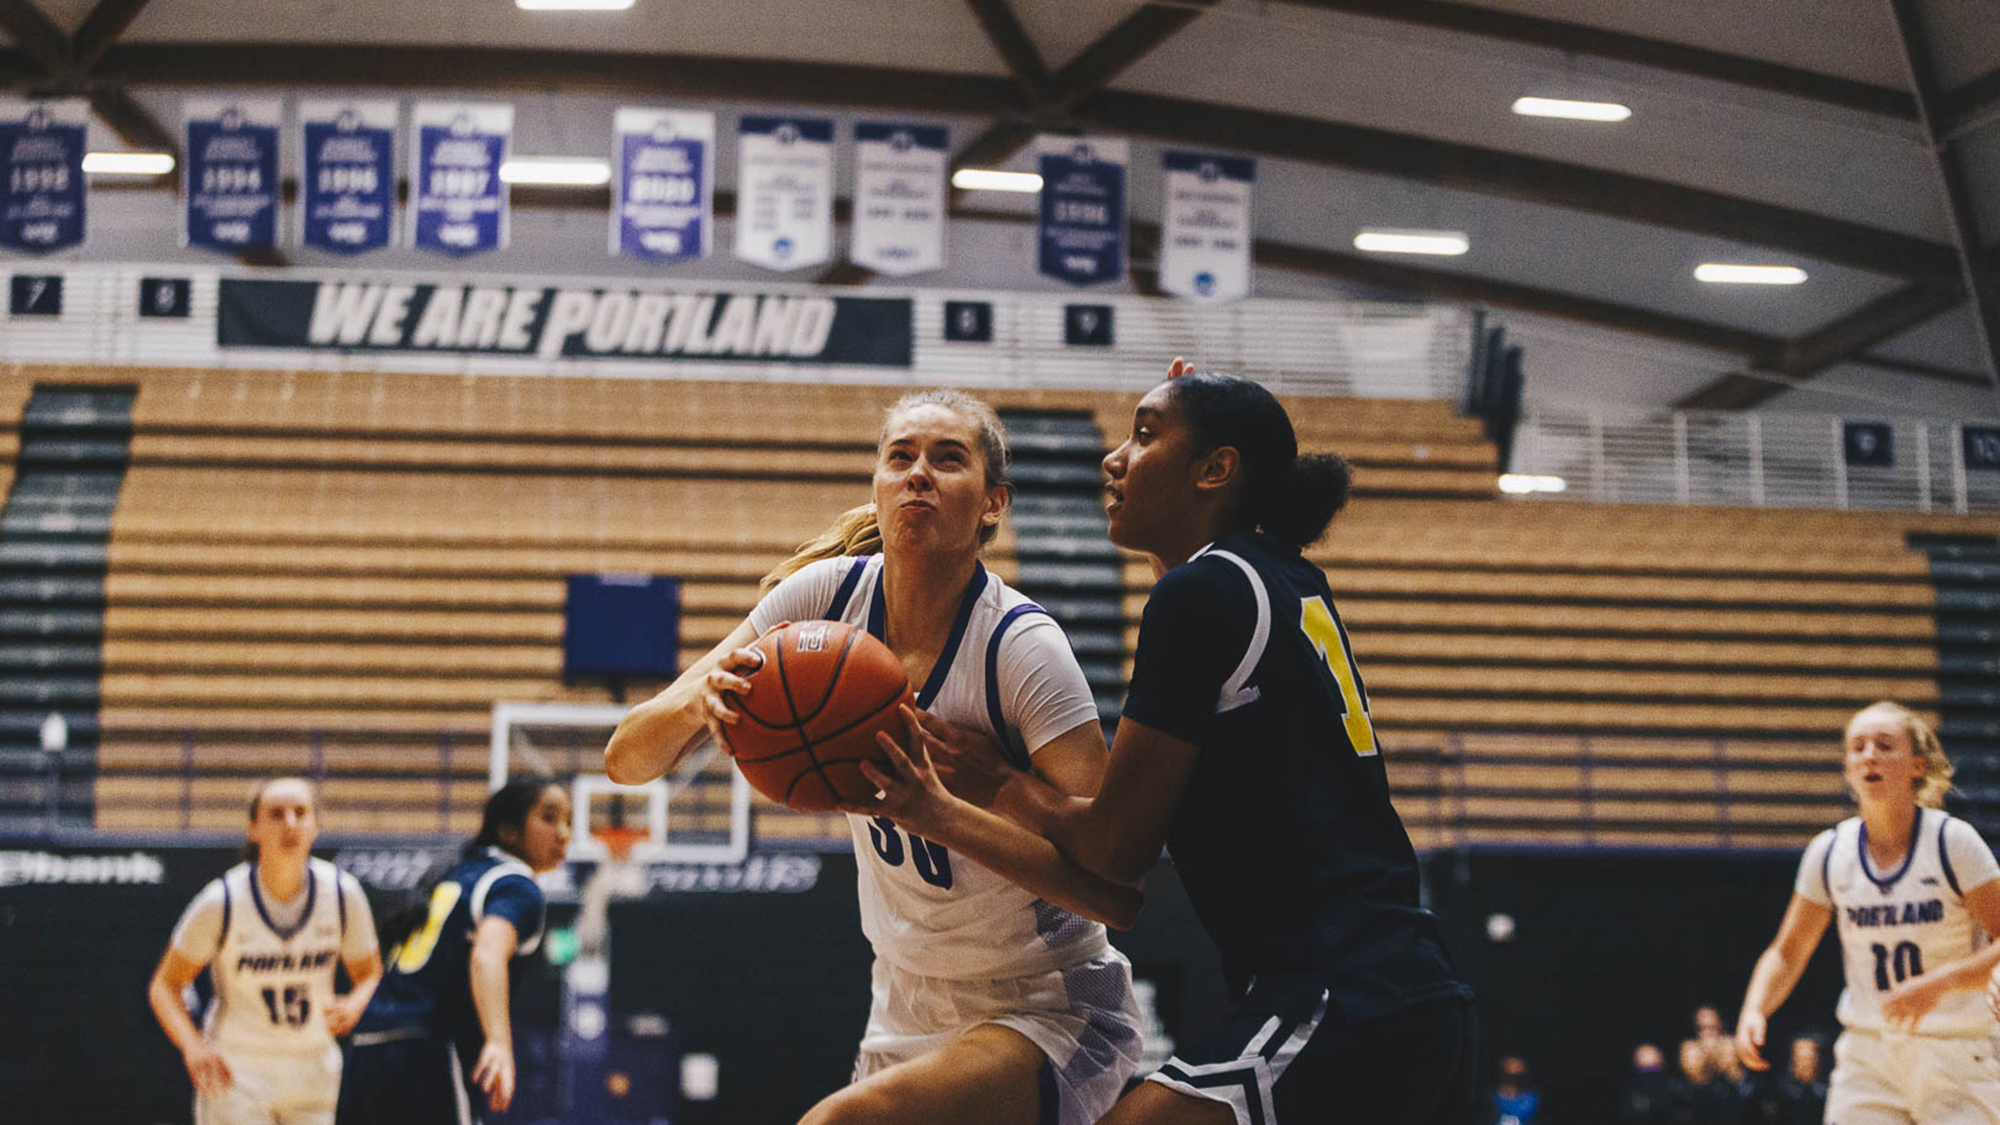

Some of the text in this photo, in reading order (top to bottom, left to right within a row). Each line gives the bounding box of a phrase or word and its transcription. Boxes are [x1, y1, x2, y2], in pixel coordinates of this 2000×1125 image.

[309, 281, 837, 360] WE ARE PORTLAND
[866, 815, 953, 890] 30
[237, 949, 337, 974] PORTLAN
[1871, 940, 1925, 991] 10
[261, 983, 311, 1029] 15
